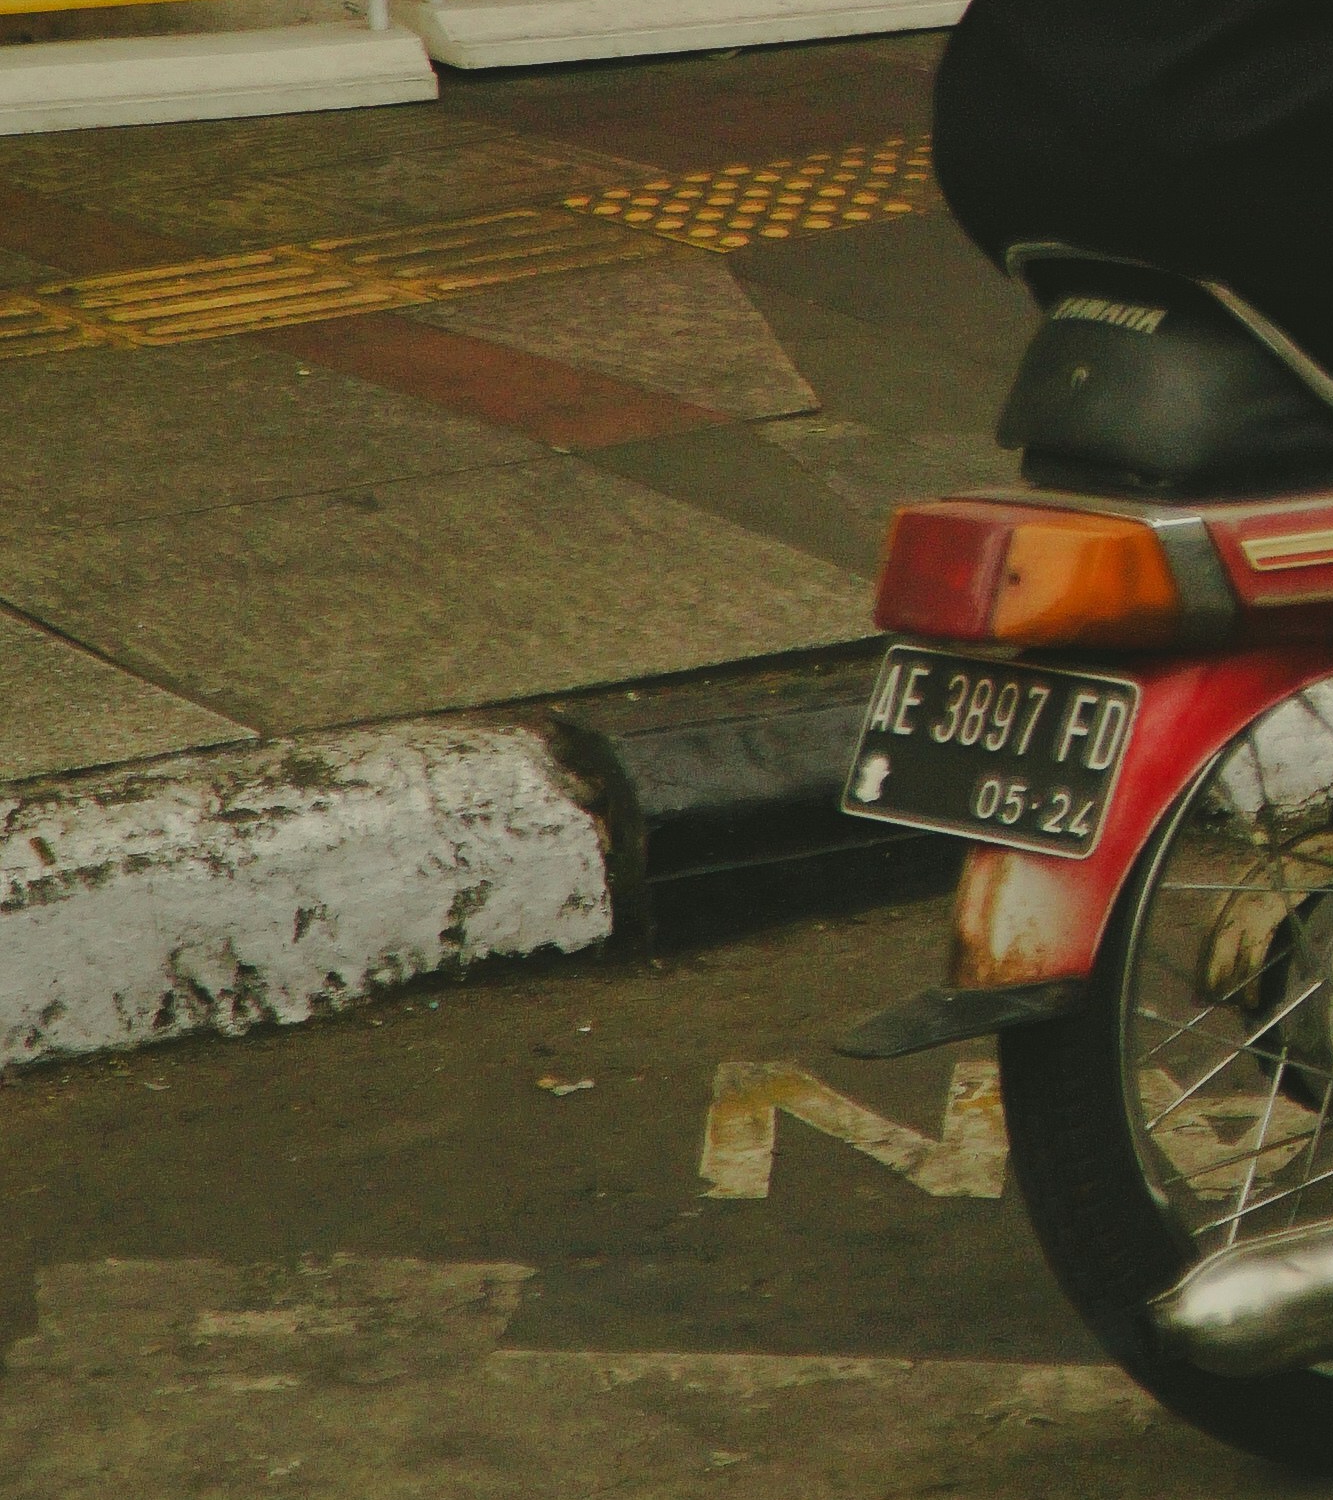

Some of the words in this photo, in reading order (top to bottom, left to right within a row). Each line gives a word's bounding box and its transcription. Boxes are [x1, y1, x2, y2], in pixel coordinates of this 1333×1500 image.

[869, 664, 937, 737] AE
[934, 676, 1049, 758] 3897
[1055, 691, 1129, 773] FD
